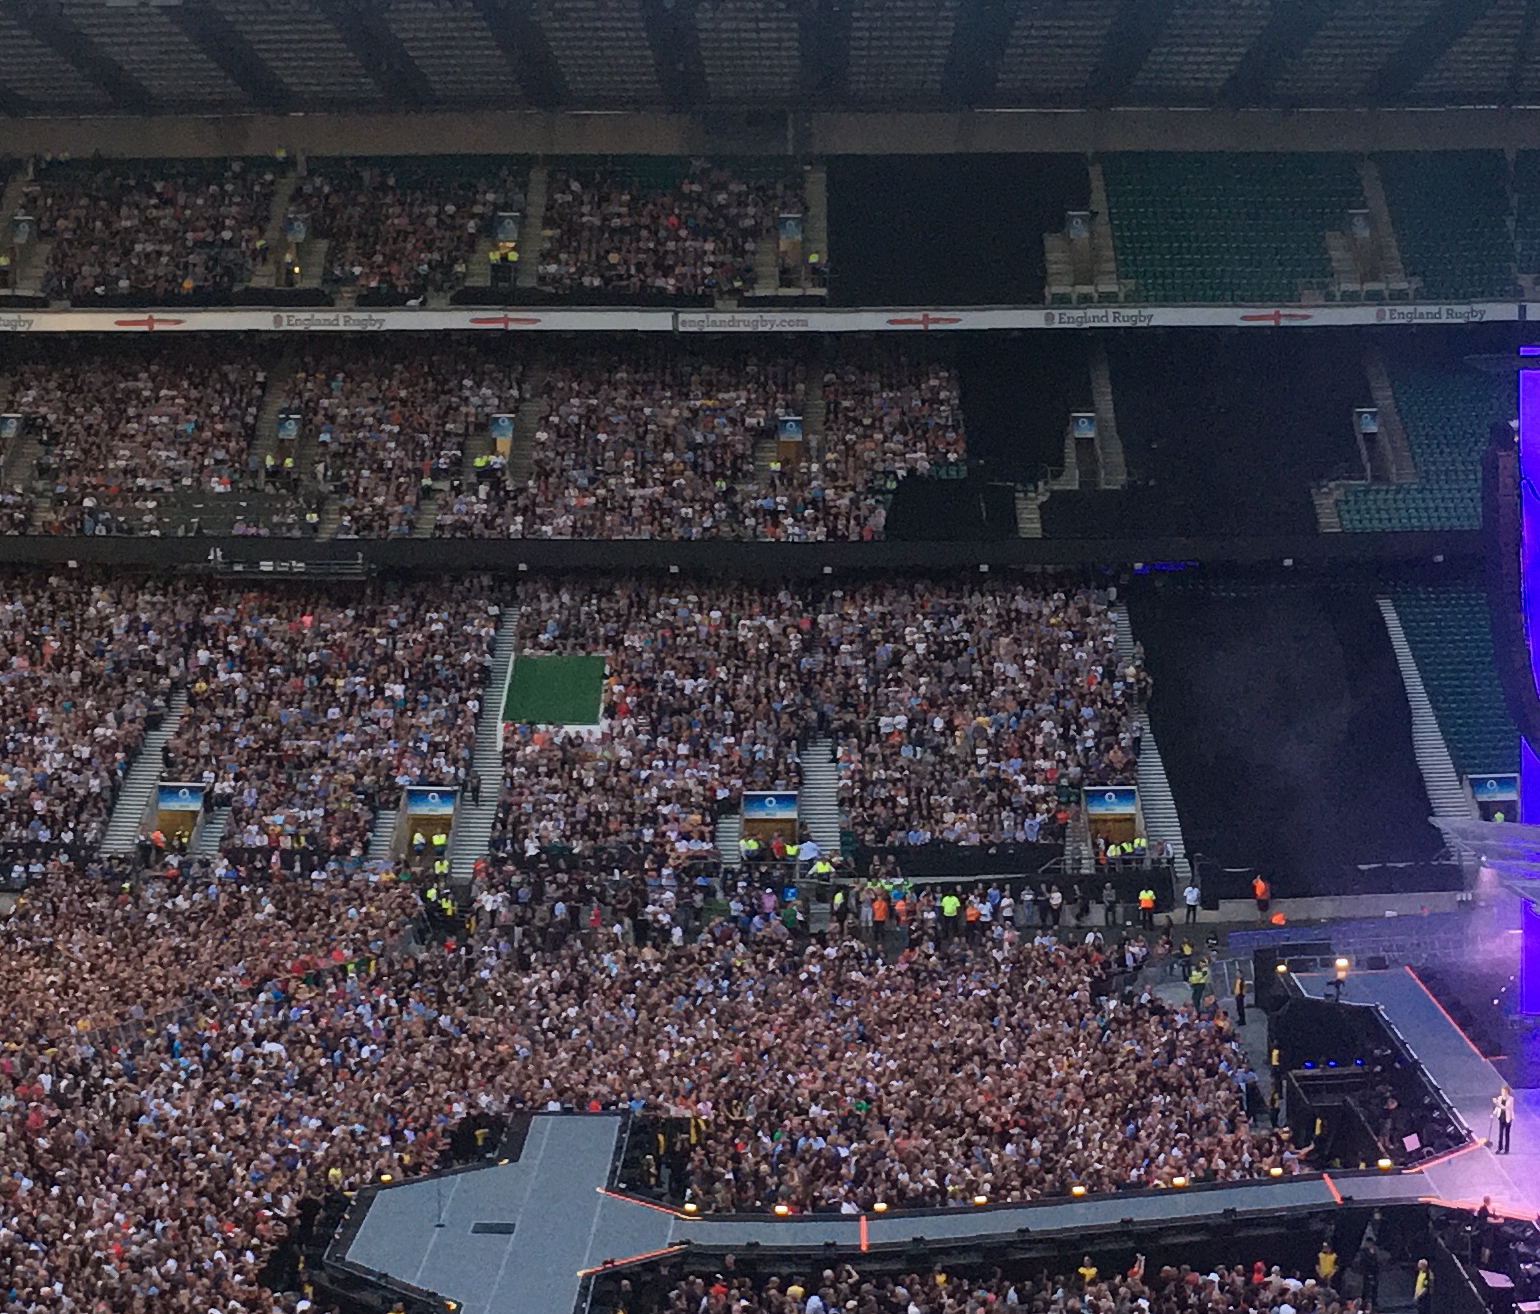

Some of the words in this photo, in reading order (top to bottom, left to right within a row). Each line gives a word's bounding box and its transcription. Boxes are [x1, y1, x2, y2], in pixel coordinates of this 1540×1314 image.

[286, 314, 343, 329] England
[345, 314, 385, 330] Rugby
[1112, 311, 1154, 326] Rugby
[1389, 307, 1443, 322] England
[1445, 307, 1486, 322] Rugby
